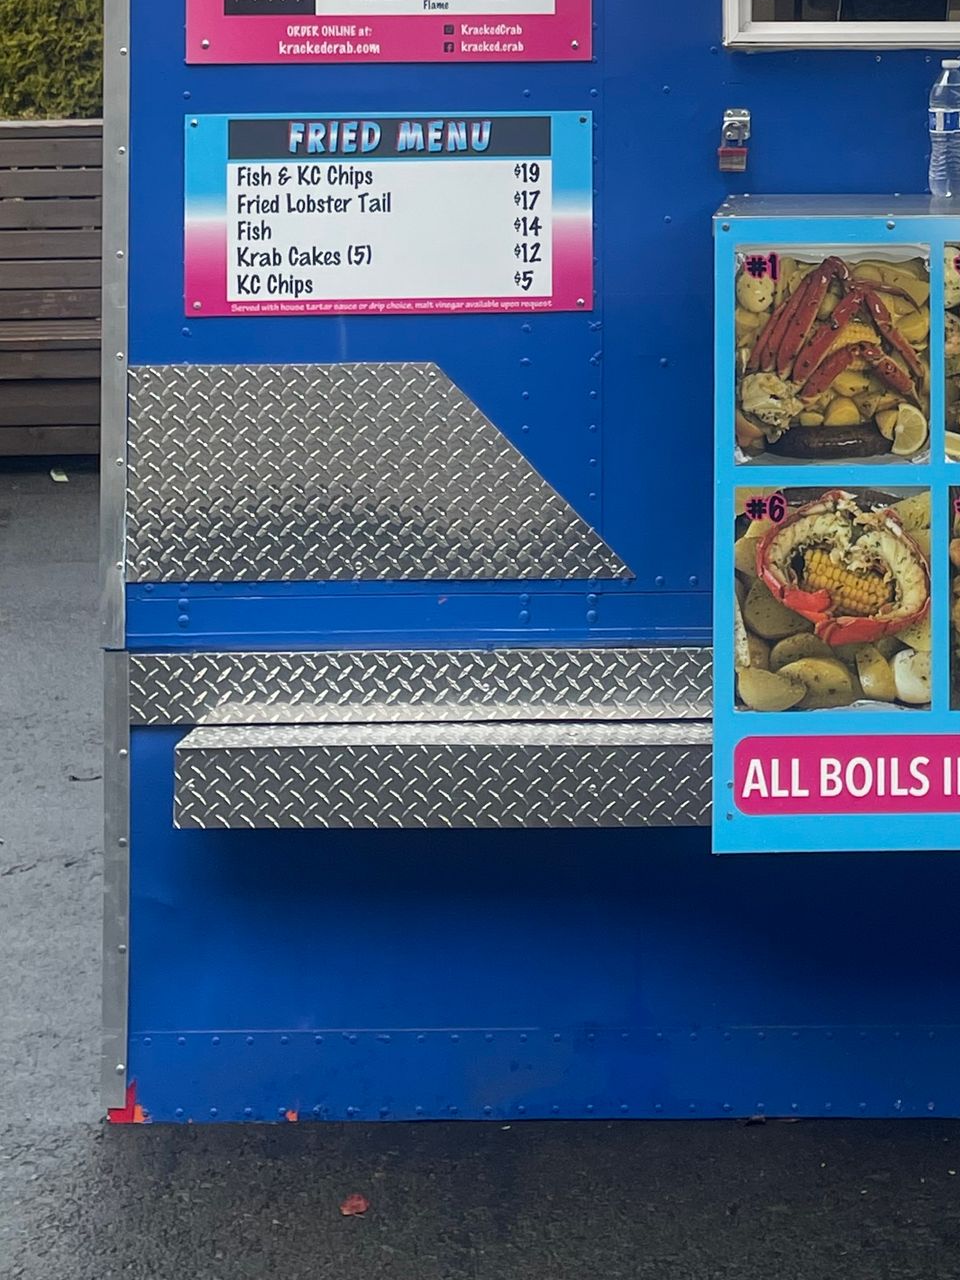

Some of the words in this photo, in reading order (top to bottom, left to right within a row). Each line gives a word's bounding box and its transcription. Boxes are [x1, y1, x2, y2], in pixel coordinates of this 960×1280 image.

[423, 0, 449, 10] Flame
[287, 26, 319, 37] ORDER
[322, 26, 356, 37] ONLINE
[359, 26, 372, 37] at:
[279, 41, 380, 54] krackedcrab.com
[288, 122, 381, 154] FRIED
[395, 120, 492, 152] MENU
[237, 166, 271, 186] Fish
[278, 167, 292, 185] &
[298, 166, 321, 185] KC
[327, 165, 373, 189] Chips
[514, 164, 540, 184] $19
[237, 195, 280, 213] Fried
[286, 193, 352, 213] Lobster
[358, 192, 391, 213] Tail
[514, 191, 540, 211] $17
[237, 220, 272, 241] Fish
[514, 217, 542, 237] $14
[237, 247, 282, 267] Krab
[289, 246, 341, 266] Cakes
[348, 244, 372, 265] (5)
[514, 243, 542, 264] $12
[746, 254, 779, 281] #1
[237, 274, 261, 294] KC
[267, 274, 313, 298] Chips
[514, 272, 533, 291] $5
[746, 494, 785, 522] #6
[742, 758, 809, 798] ALL
[819, 756, 930, 797] BOILS
